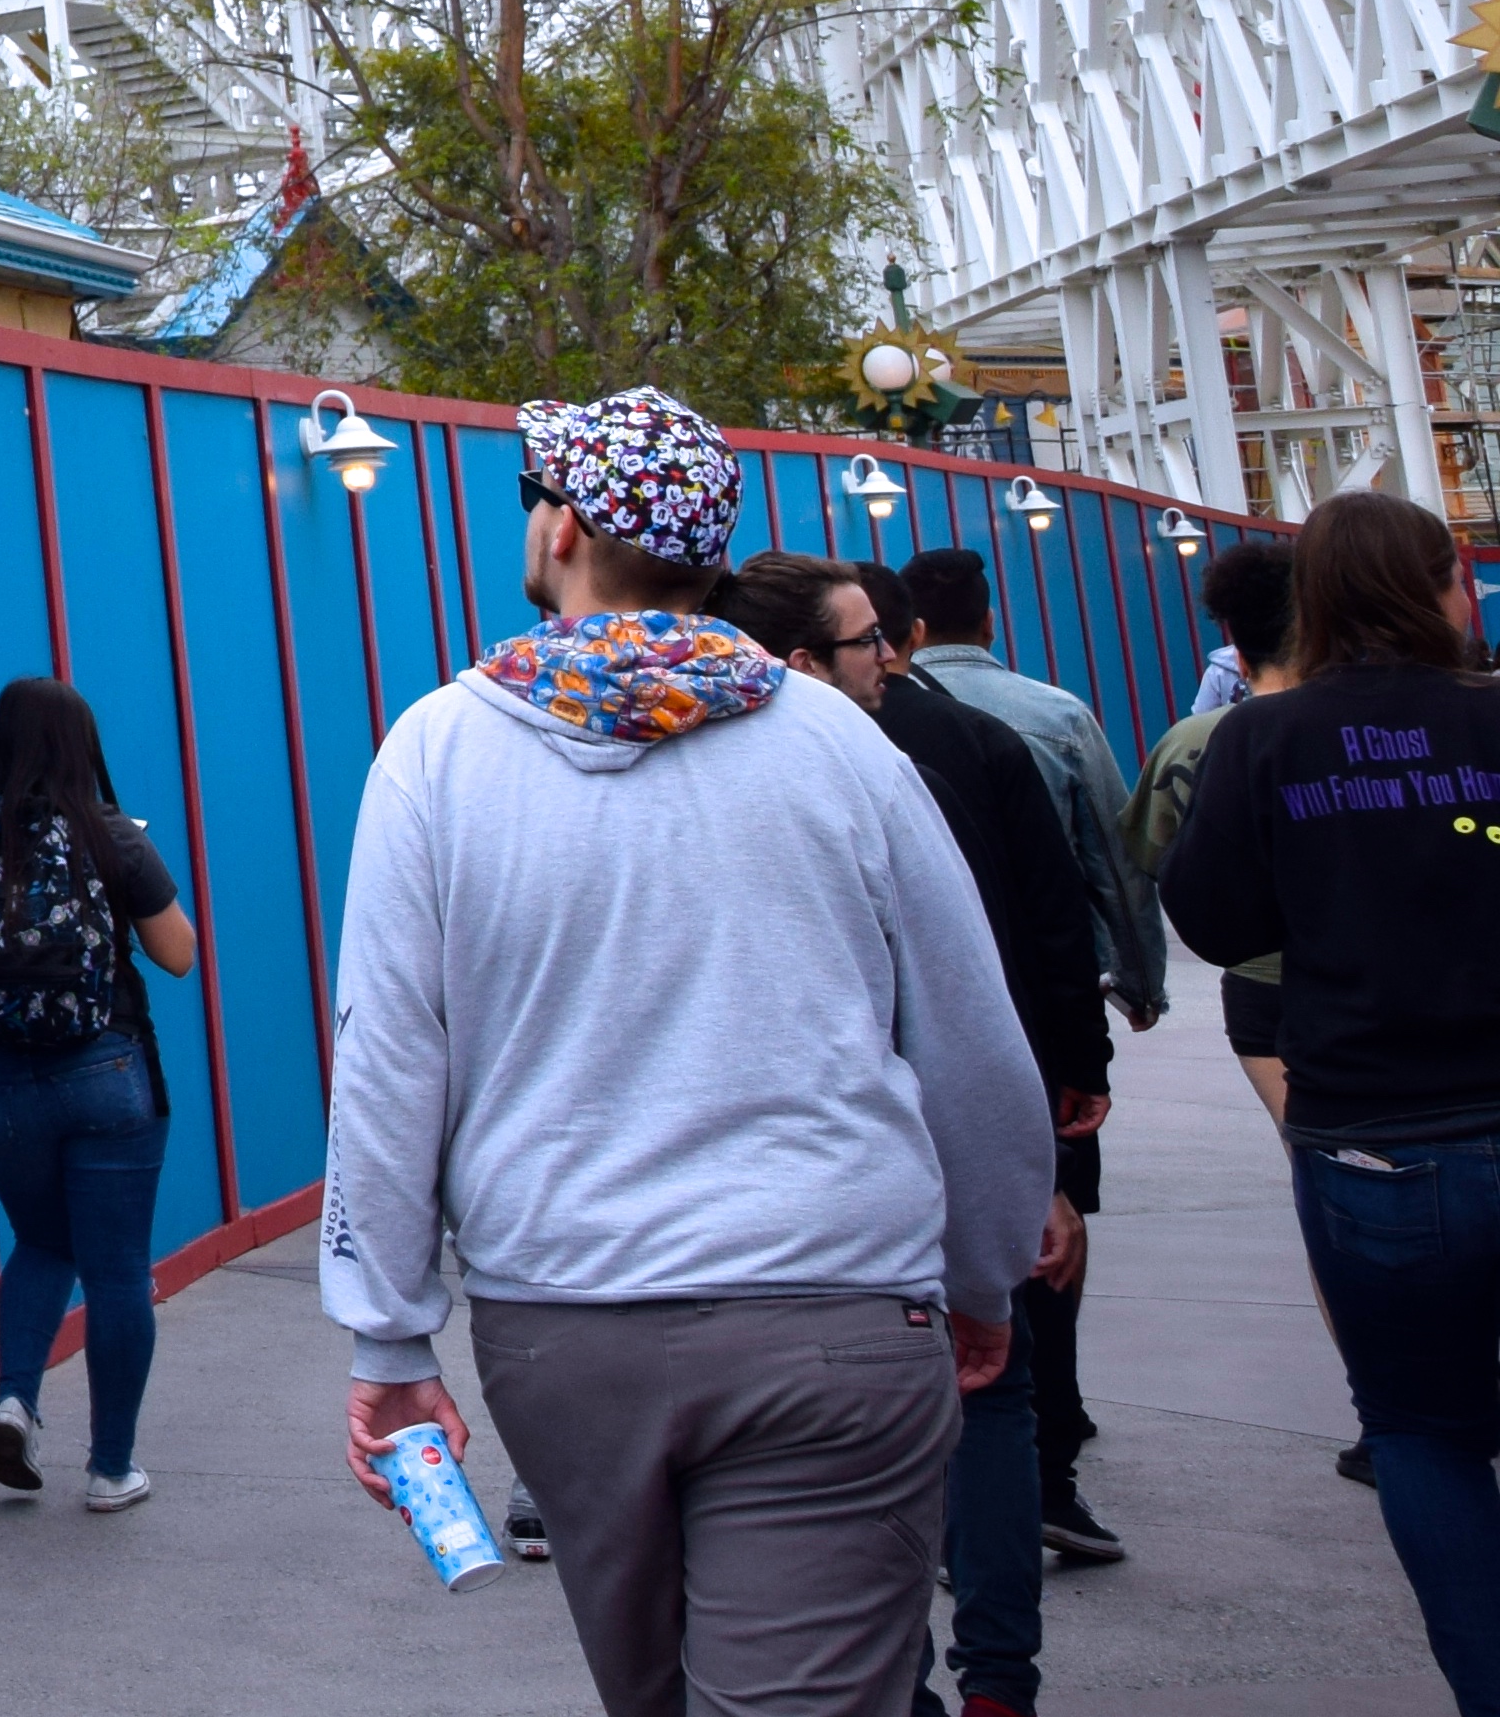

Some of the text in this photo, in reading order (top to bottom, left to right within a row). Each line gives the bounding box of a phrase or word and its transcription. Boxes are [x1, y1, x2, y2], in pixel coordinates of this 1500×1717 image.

[1340, 725, 1431, 764] A Ghost
[1279, 781, 1332, 822] Will
[1327, 775, 1405, 811] Follow
[1406, 770, 1457, 807] You
[322, 1171, 341, 1247] RESORT
